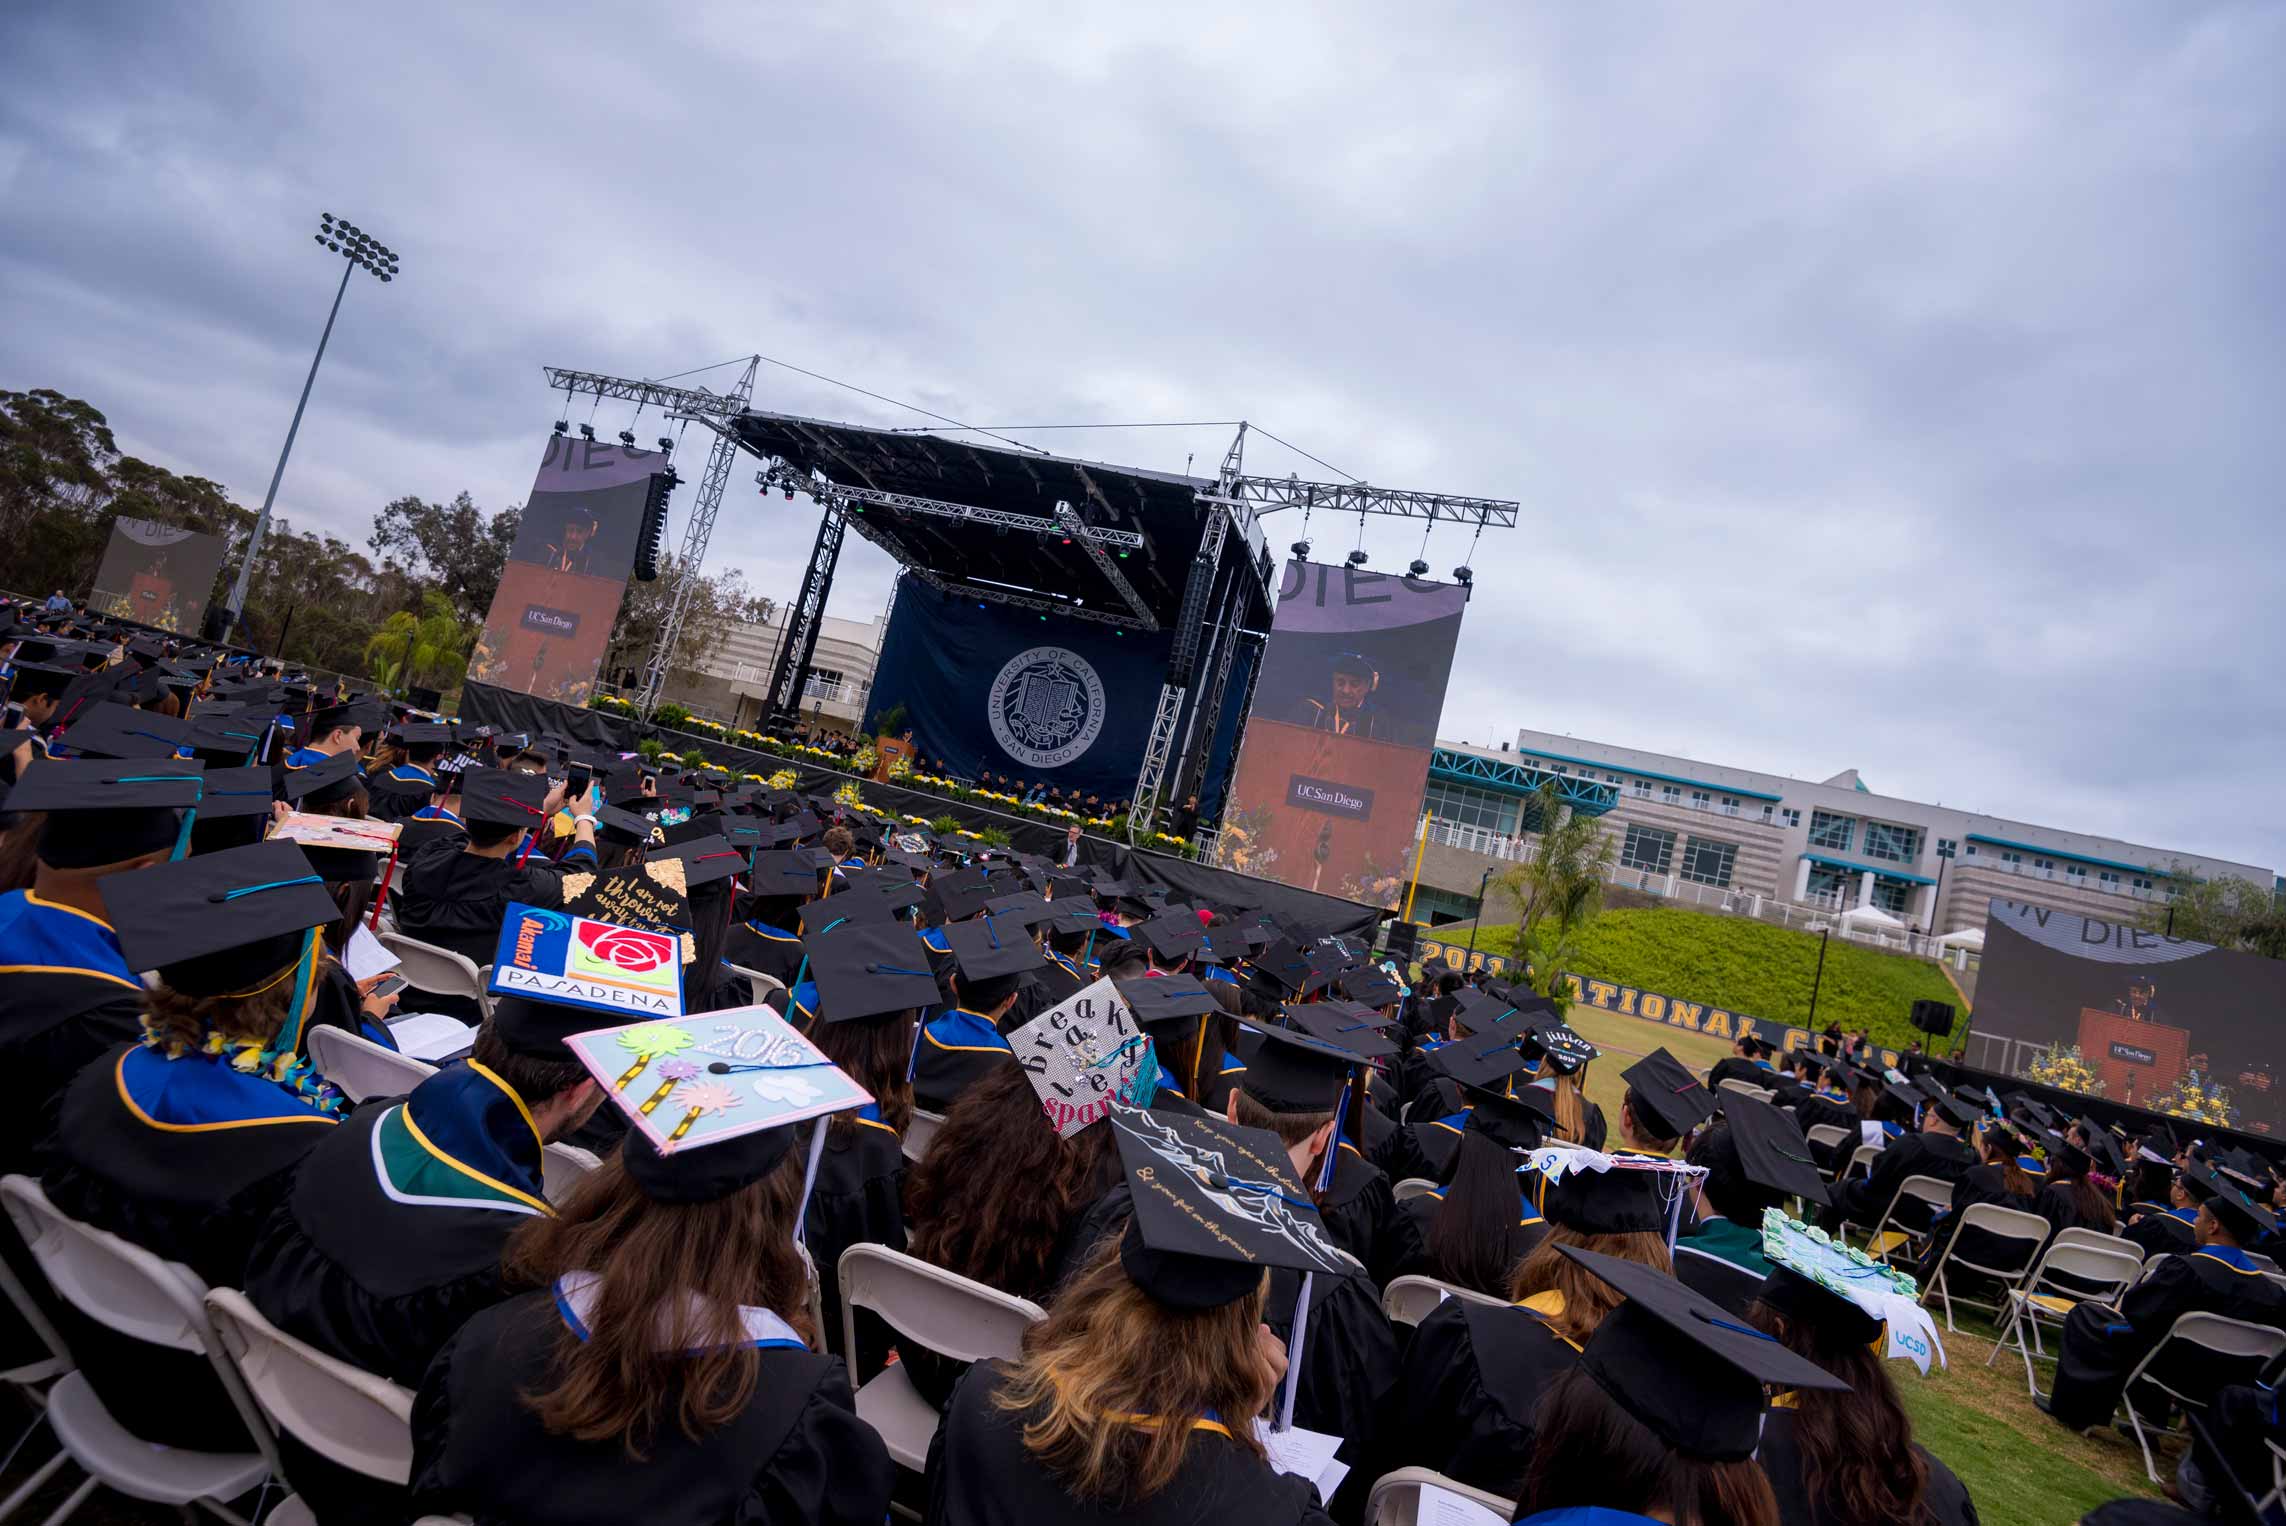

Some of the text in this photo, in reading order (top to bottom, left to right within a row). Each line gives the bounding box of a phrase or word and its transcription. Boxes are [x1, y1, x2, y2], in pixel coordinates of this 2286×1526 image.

[528, 610, 541, 622] UC
[991, 649, 1102, 742] UNIVERSITY OF CALIFORNIA
[1001, 733, 1026, 758] SAN
[1031, 749, 1072, 764] DIEGO
[1297, 784, 1364, 811] UC San Diego
[627, 877, 679, 917] I am not
[512, 916, 545, 971] Akamai
[508, 970, 670, 1011] PASADENA
[1420, 940, 1504, 978] 2011
[1529, 966, 1763, 1043] ATIONAL
[695, 1024, 807, 1067] 2016
[1020, 998, 1128, 1076] break
[1895, 1330, 1926, 1356] UCSD
